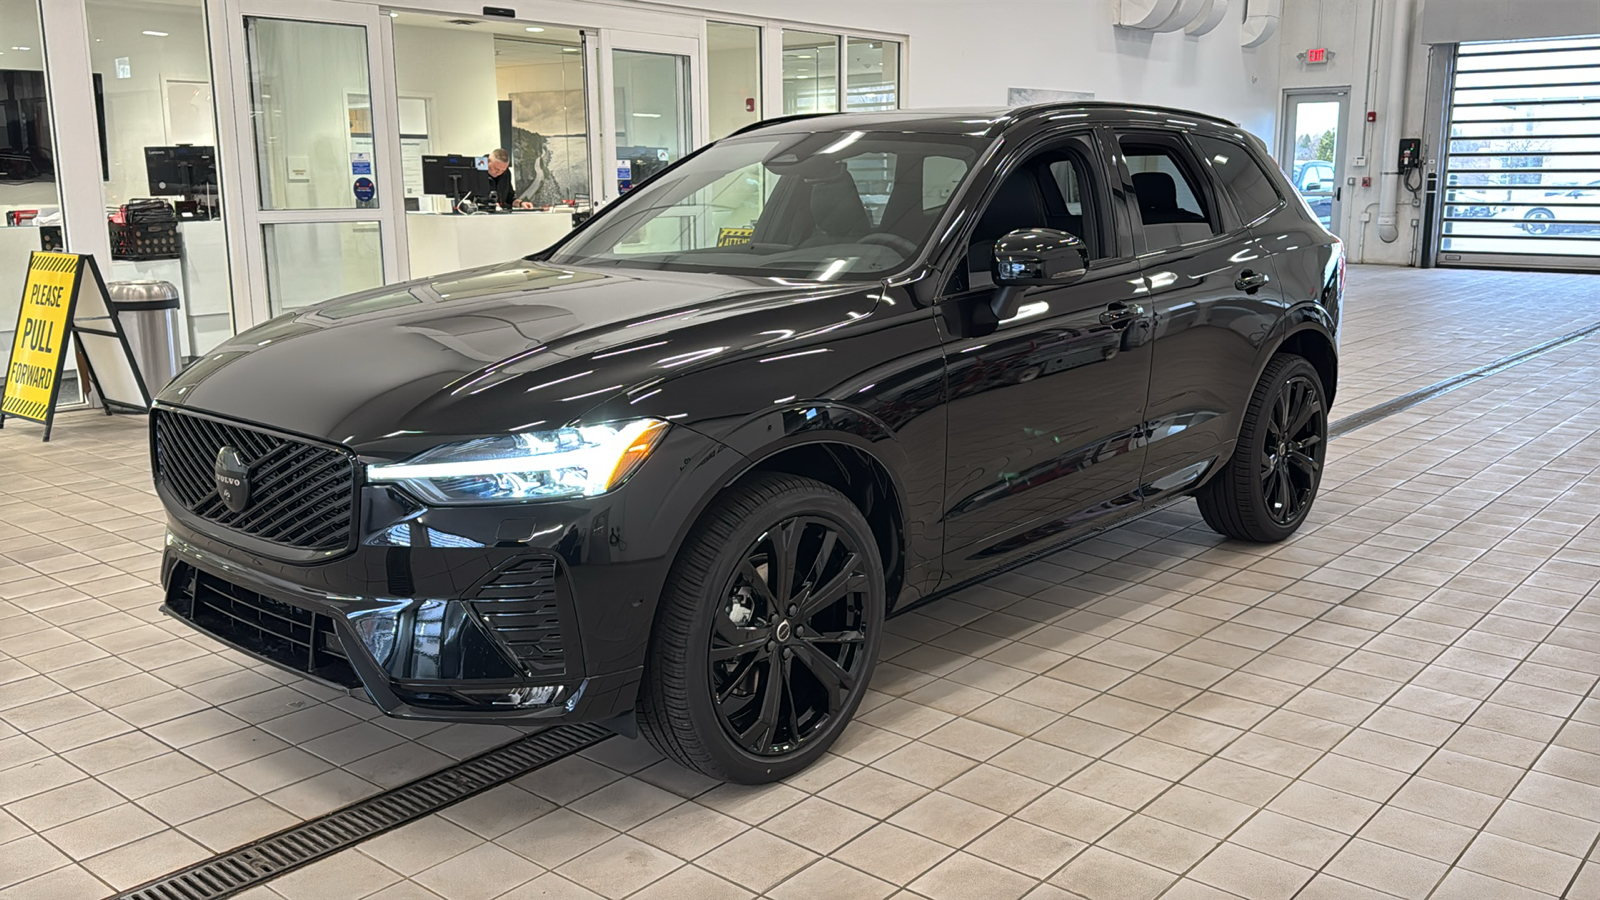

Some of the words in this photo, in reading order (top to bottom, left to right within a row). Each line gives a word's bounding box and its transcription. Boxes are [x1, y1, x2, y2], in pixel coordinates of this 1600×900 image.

[1309, 48, 1325, 62] EXIT
[30, 284, 64, 308] PLEASE
[21, 318, 54, 354] PULL
[10, 362, 53, 390] FORWARD
[216, 473, 241, 487] VOLVO
